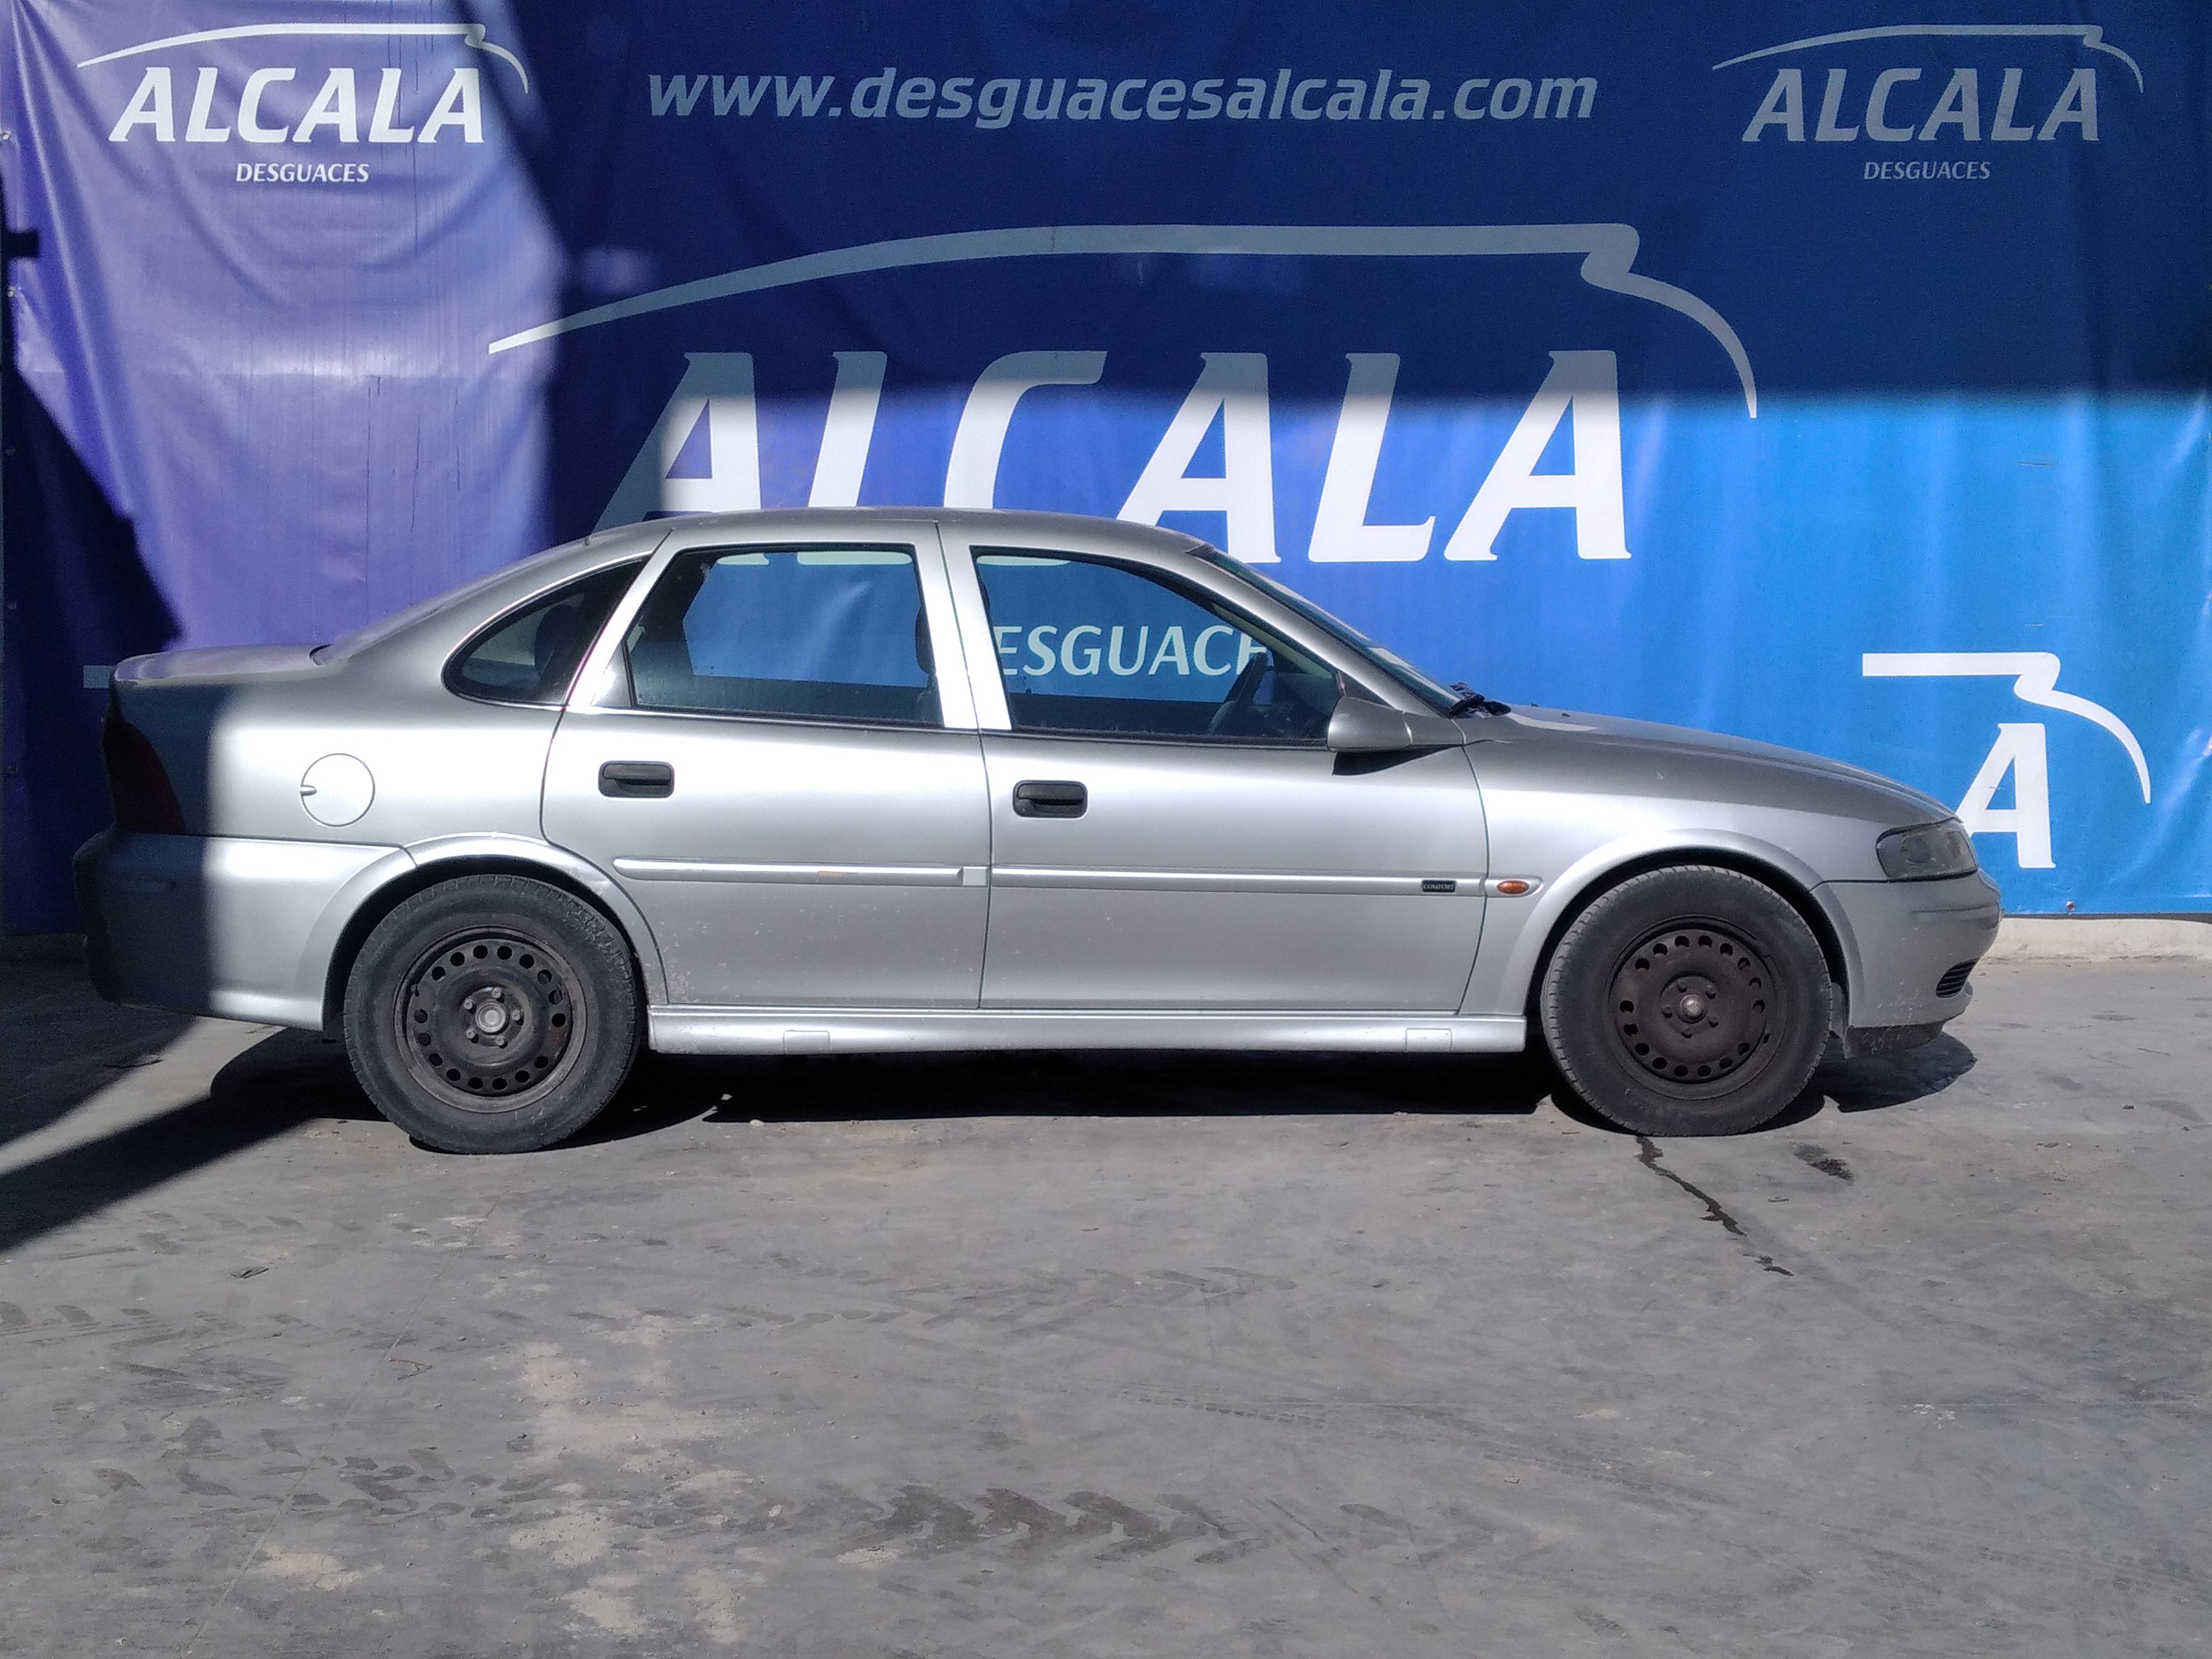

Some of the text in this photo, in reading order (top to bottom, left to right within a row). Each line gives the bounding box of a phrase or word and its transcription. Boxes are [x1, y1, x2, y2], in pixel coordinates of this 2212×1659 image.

[108, 67, 484, 143] ALCALA
[648, 67, 1598, 130] www.desguacesalcala.com
[1741, 67, 2100, 142] ALCALA
[236, 162, 369, 183] DESGUACES
[1863, 161, 1991, 180] DESGUACES
[589, 350, 1633, 564] ALCALA
